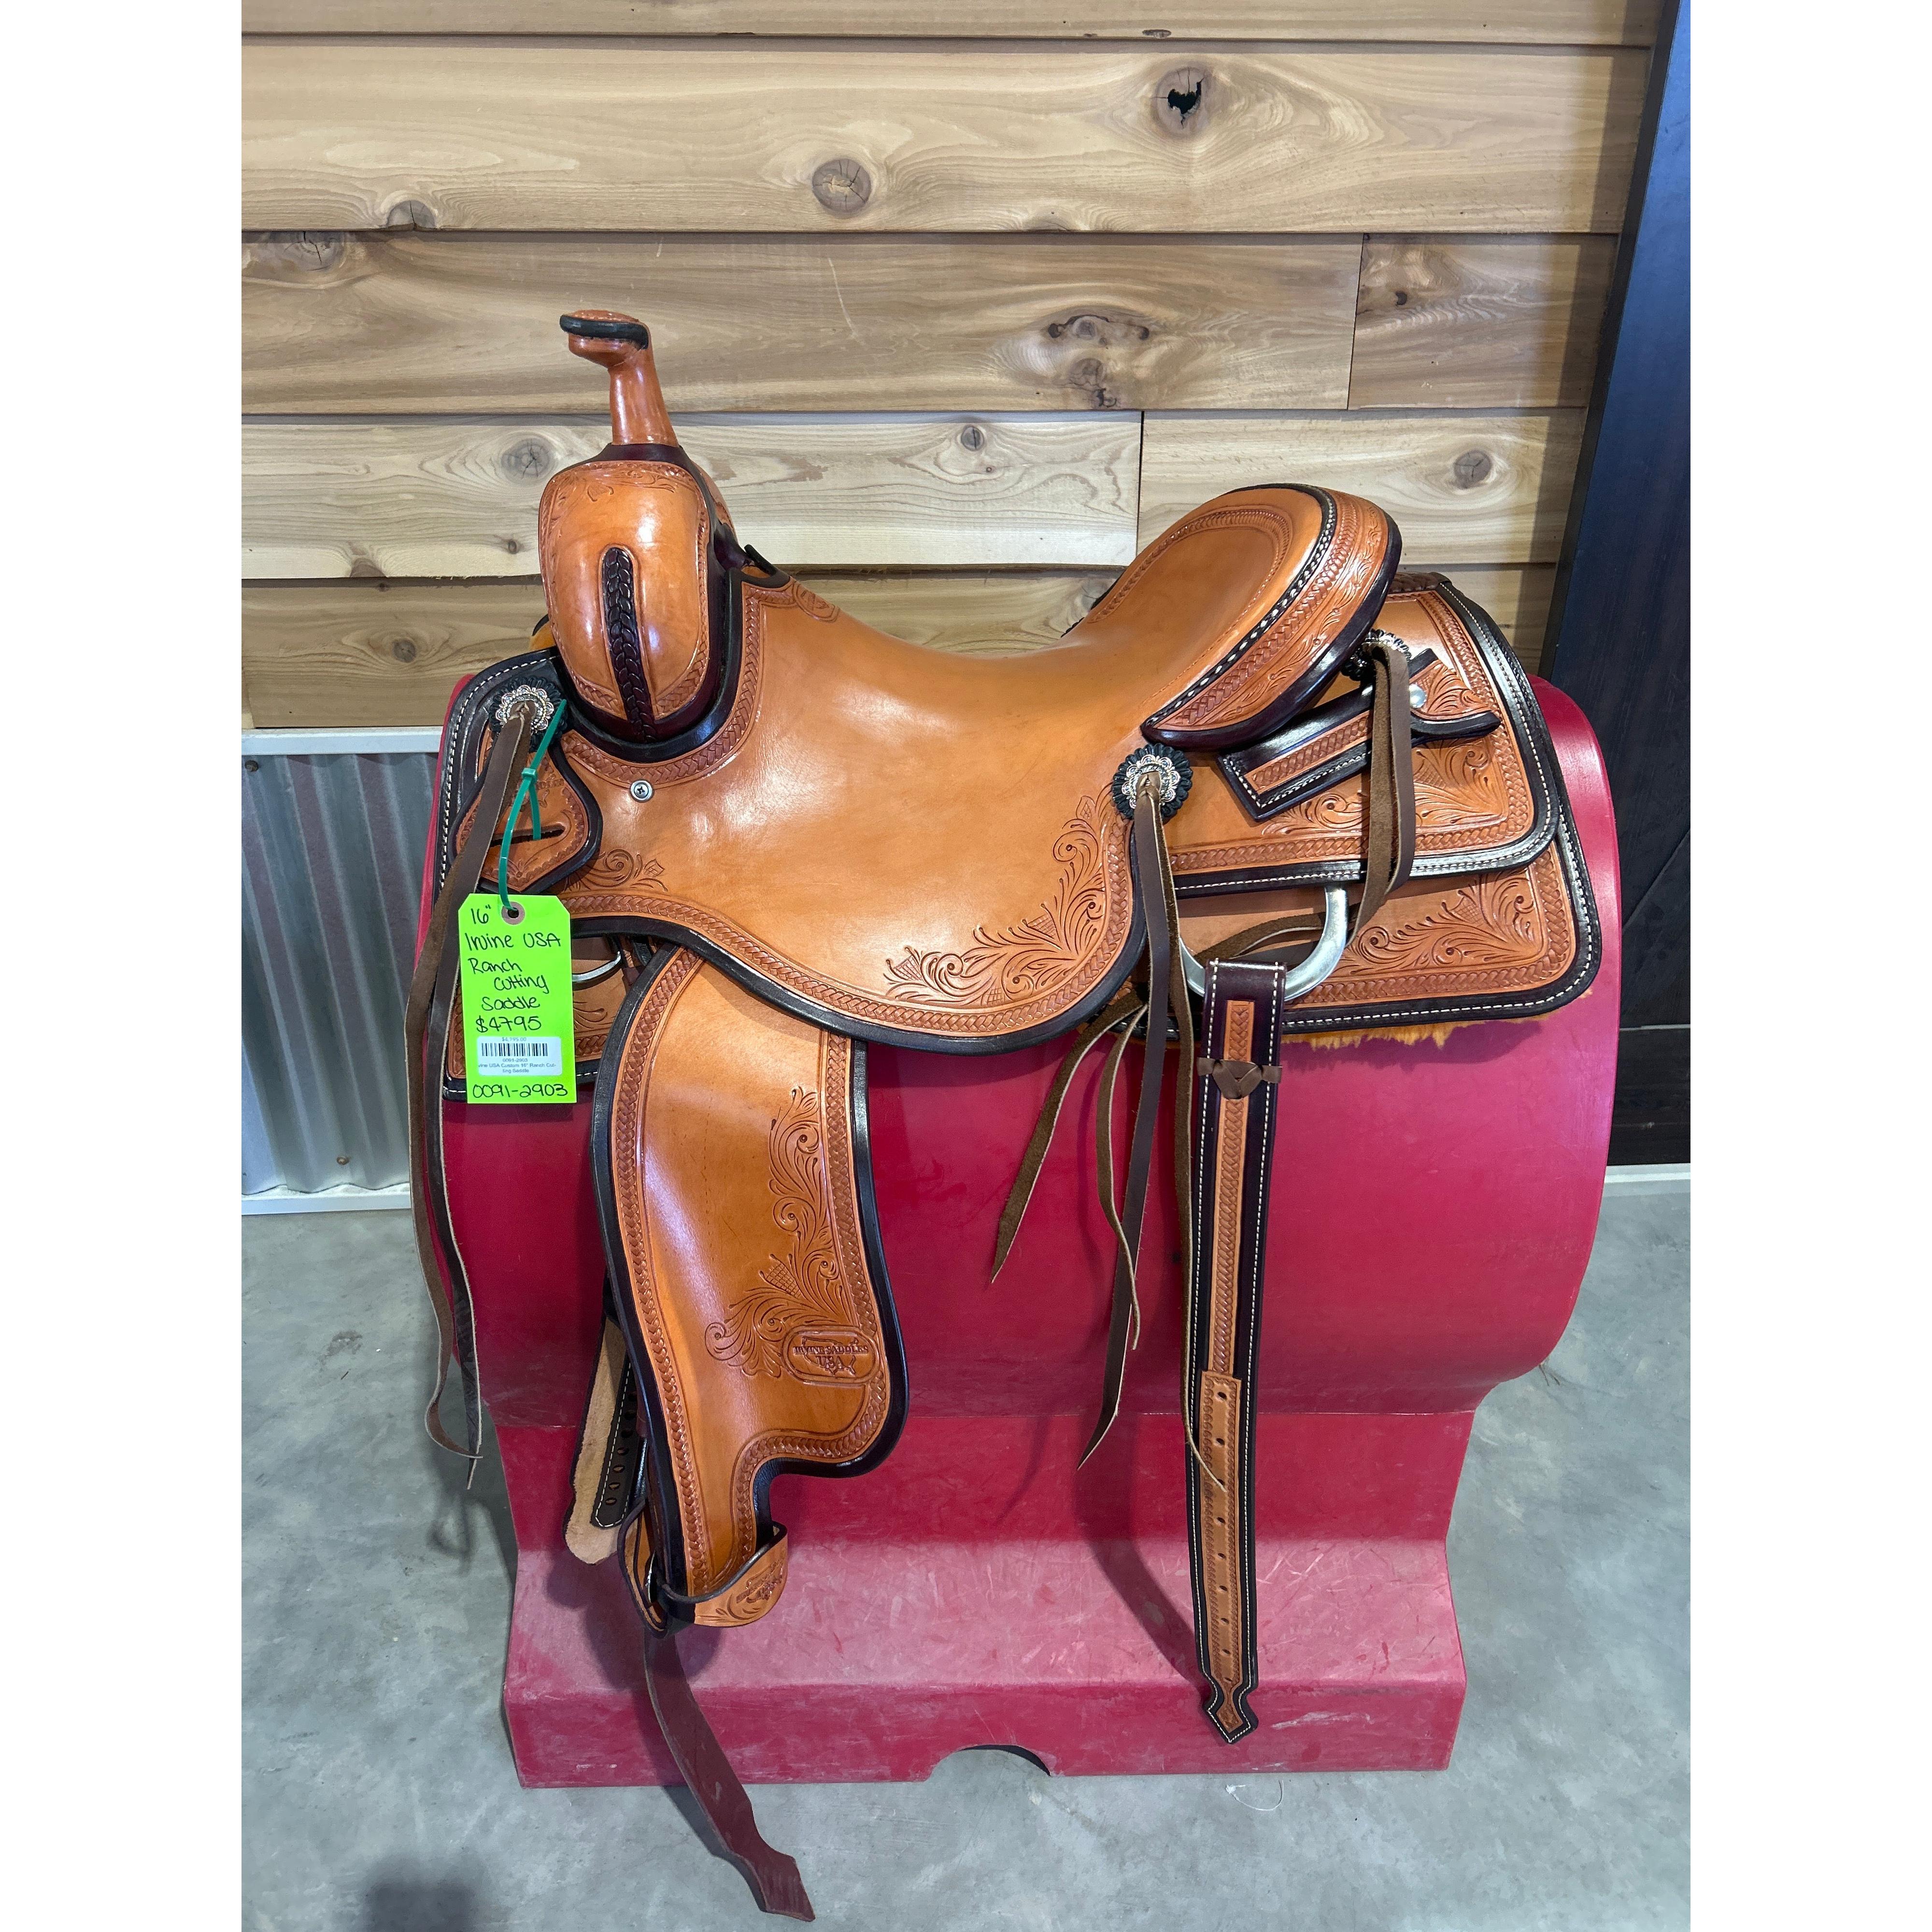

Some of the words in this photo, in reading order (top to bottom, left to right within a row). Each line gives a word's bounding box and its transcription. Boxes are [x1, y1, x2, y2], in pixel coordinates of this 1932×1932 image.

[471, 904, 491, 924] 16"
[465, 933, 514, 951] Irvine
[523, 932, 561, 948] USA
[468, 958, 523, 974] Ranch
[494, 974, 550, 994] Cutting
[482, 996, 540, 1011] Saddle
[476, 1015, 542, 1033] $4795
[472, 1084, 568, 1098] 0091-2903
